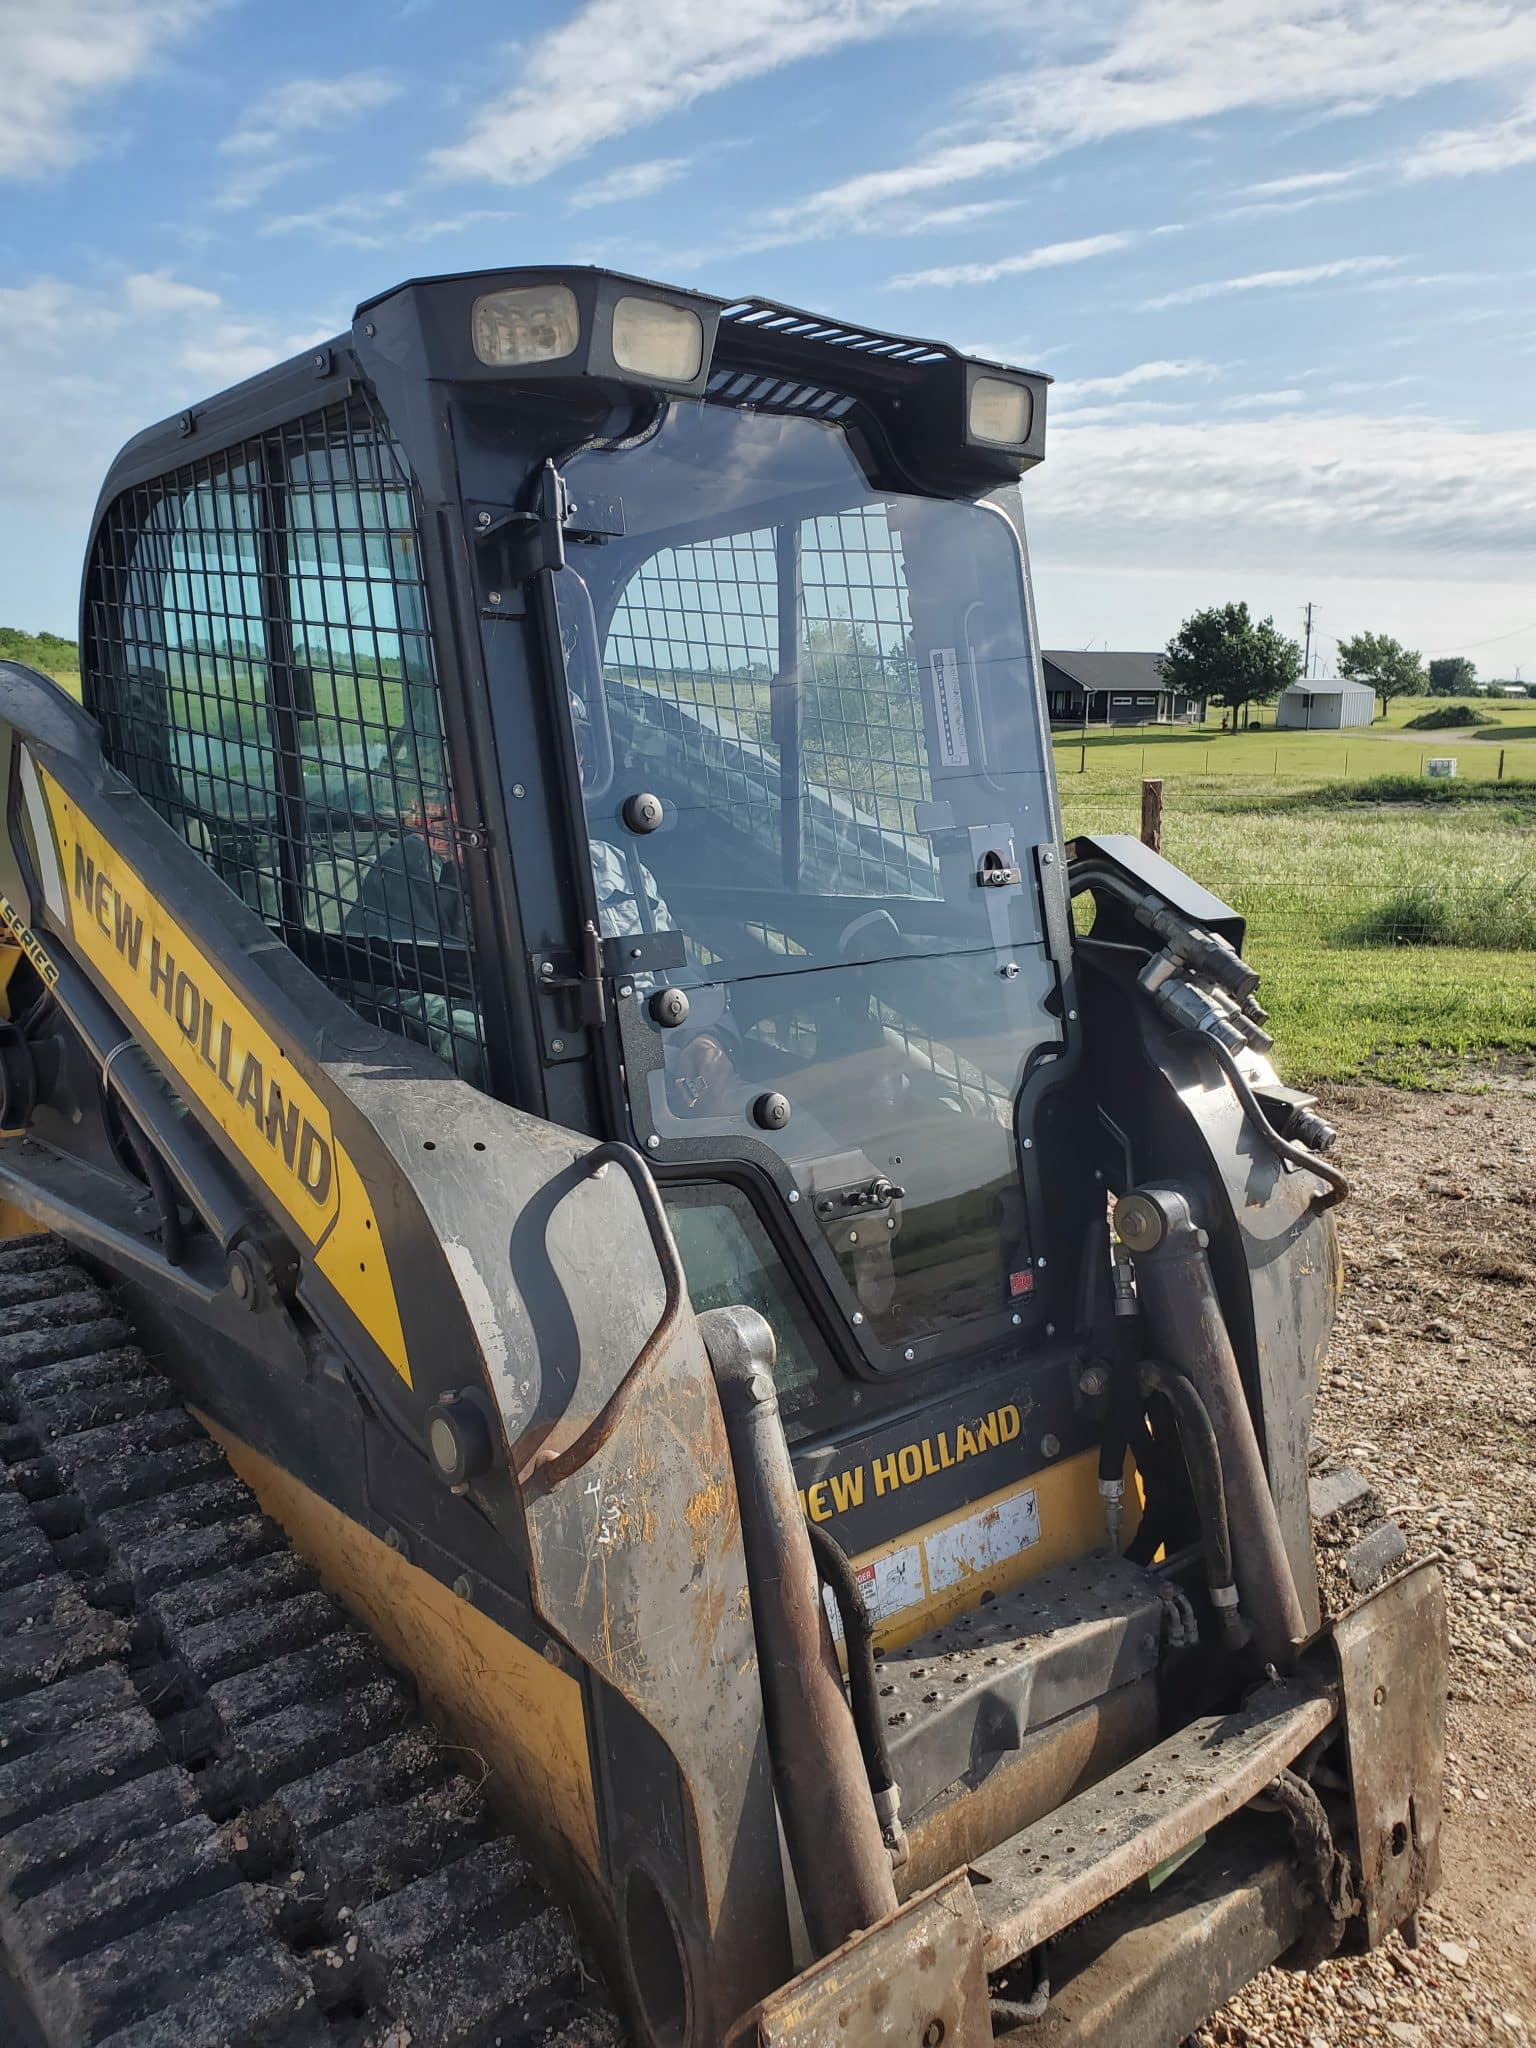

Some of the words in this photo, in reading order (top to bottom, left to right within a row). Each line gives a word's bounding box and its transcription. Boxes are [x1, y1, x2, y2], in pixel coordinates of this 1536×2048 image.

[4, 904, 58, 983] SERIES
[74, 844, 144, 973] NEW
[150, 936, 333, 1203] HOLLAND
[872, 1404, 1021, 1497] HOLLAND
